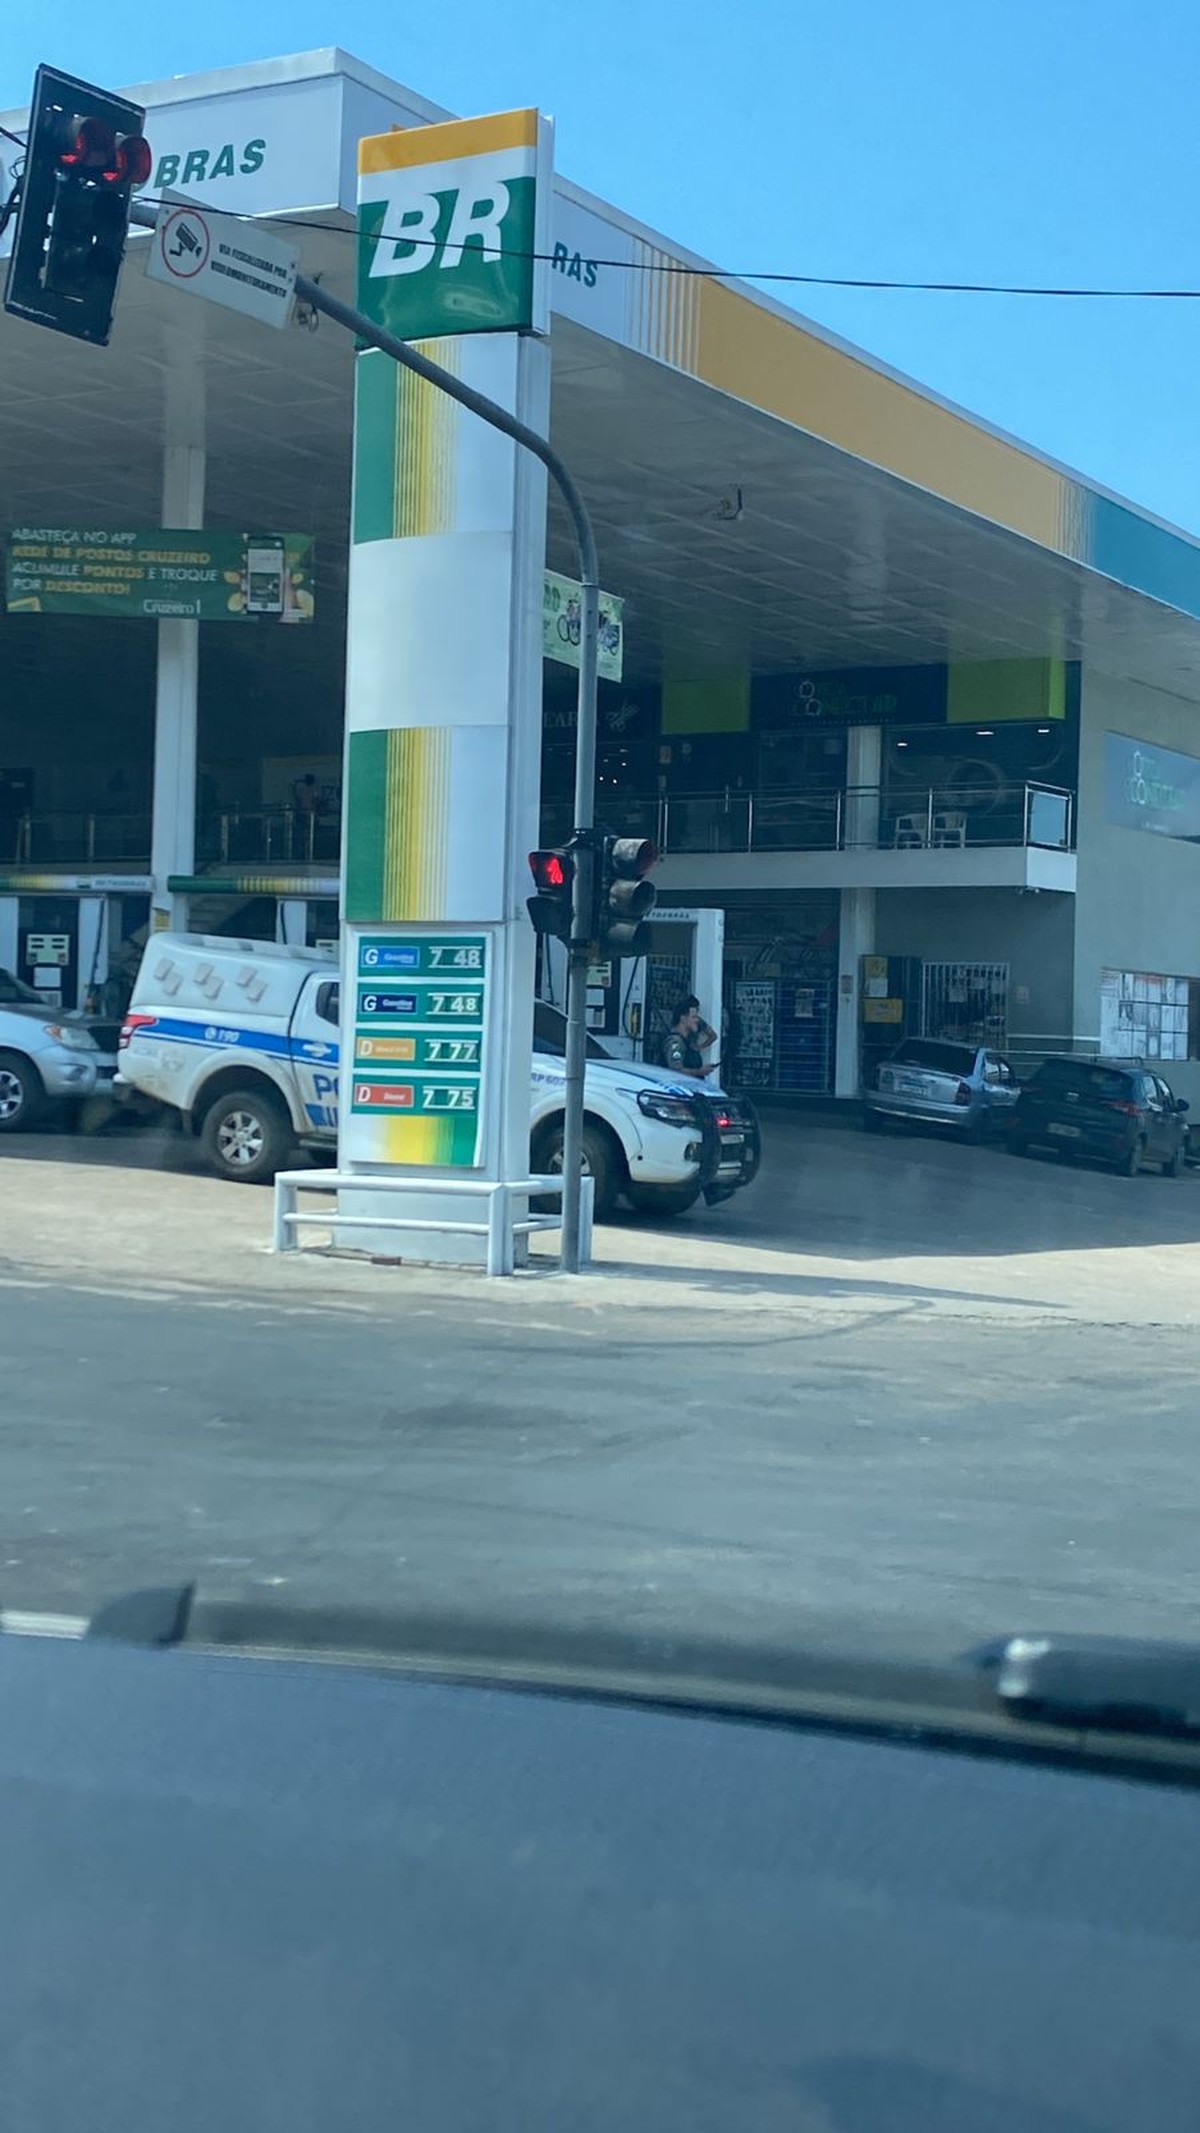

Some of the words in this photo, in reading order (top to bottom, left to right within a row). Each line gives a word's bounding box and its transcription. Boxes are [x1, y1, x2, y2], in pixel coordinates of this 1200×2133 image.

[133, 139, 267, 192] BRAS
[368, 178, 510, 278] BR
[11, 528, 79, 544] ABASTEÇA
[83, 531, 109, 543] NO
[110, 532, 137, 544] APP
[53, 546, 72, 558] DE
[76, 548, 133, 561] POSTOS
[138, 551, 211, 564] CRUZEIRO
[83, 564, 145, 579] PONTOS
[148, 567, 157, 579] E
[161, 568, 218, 582] TROQUE
[13, 578, 42, 590] POR
[365, 948, 379, 965] G
[363, 995, 378, 1011] G
[217, 1029, 240, 1043] 190
[360, 1040, 373, 1056] D
[358, 1086, 372, 1102] D
